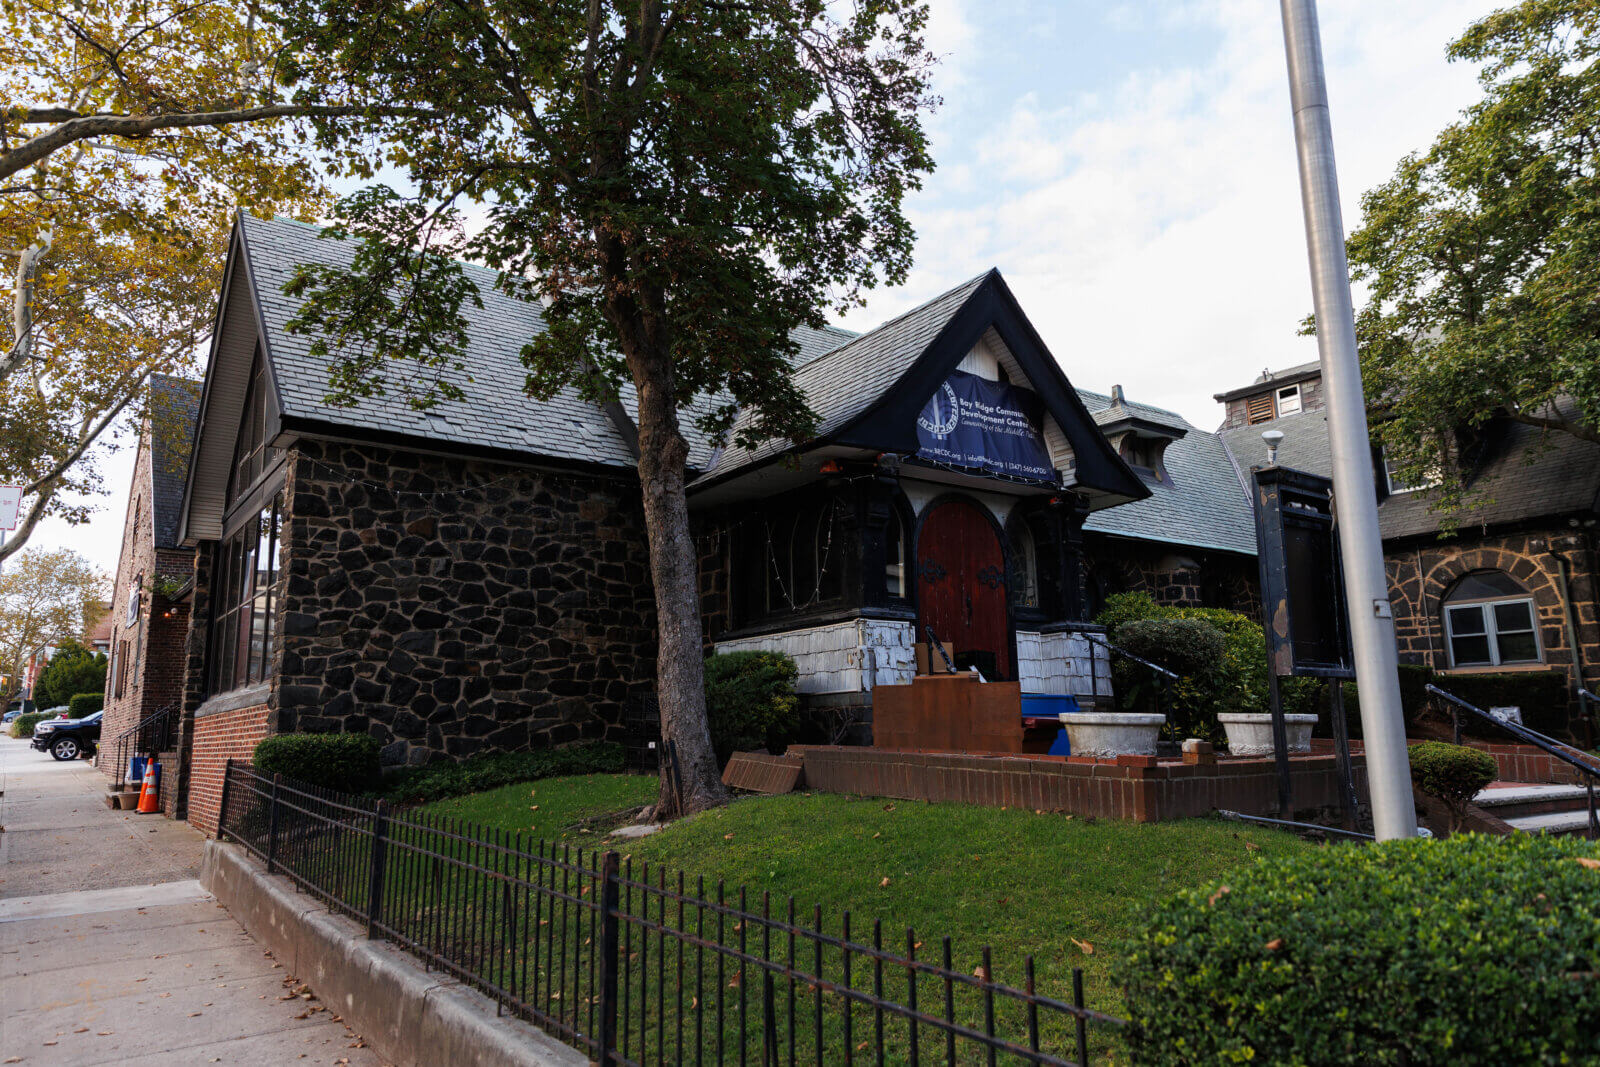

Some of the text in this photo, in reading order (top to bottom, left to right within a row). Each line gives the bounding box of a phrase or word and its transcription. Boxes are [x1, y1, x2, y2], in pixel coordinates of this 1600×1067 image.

[960, 398, 972, 409] Bay
[975, 401, 994, 413] Ridge
[961, 408, 1004, 424] Development
[1006, 418, 1029, 429] Center
